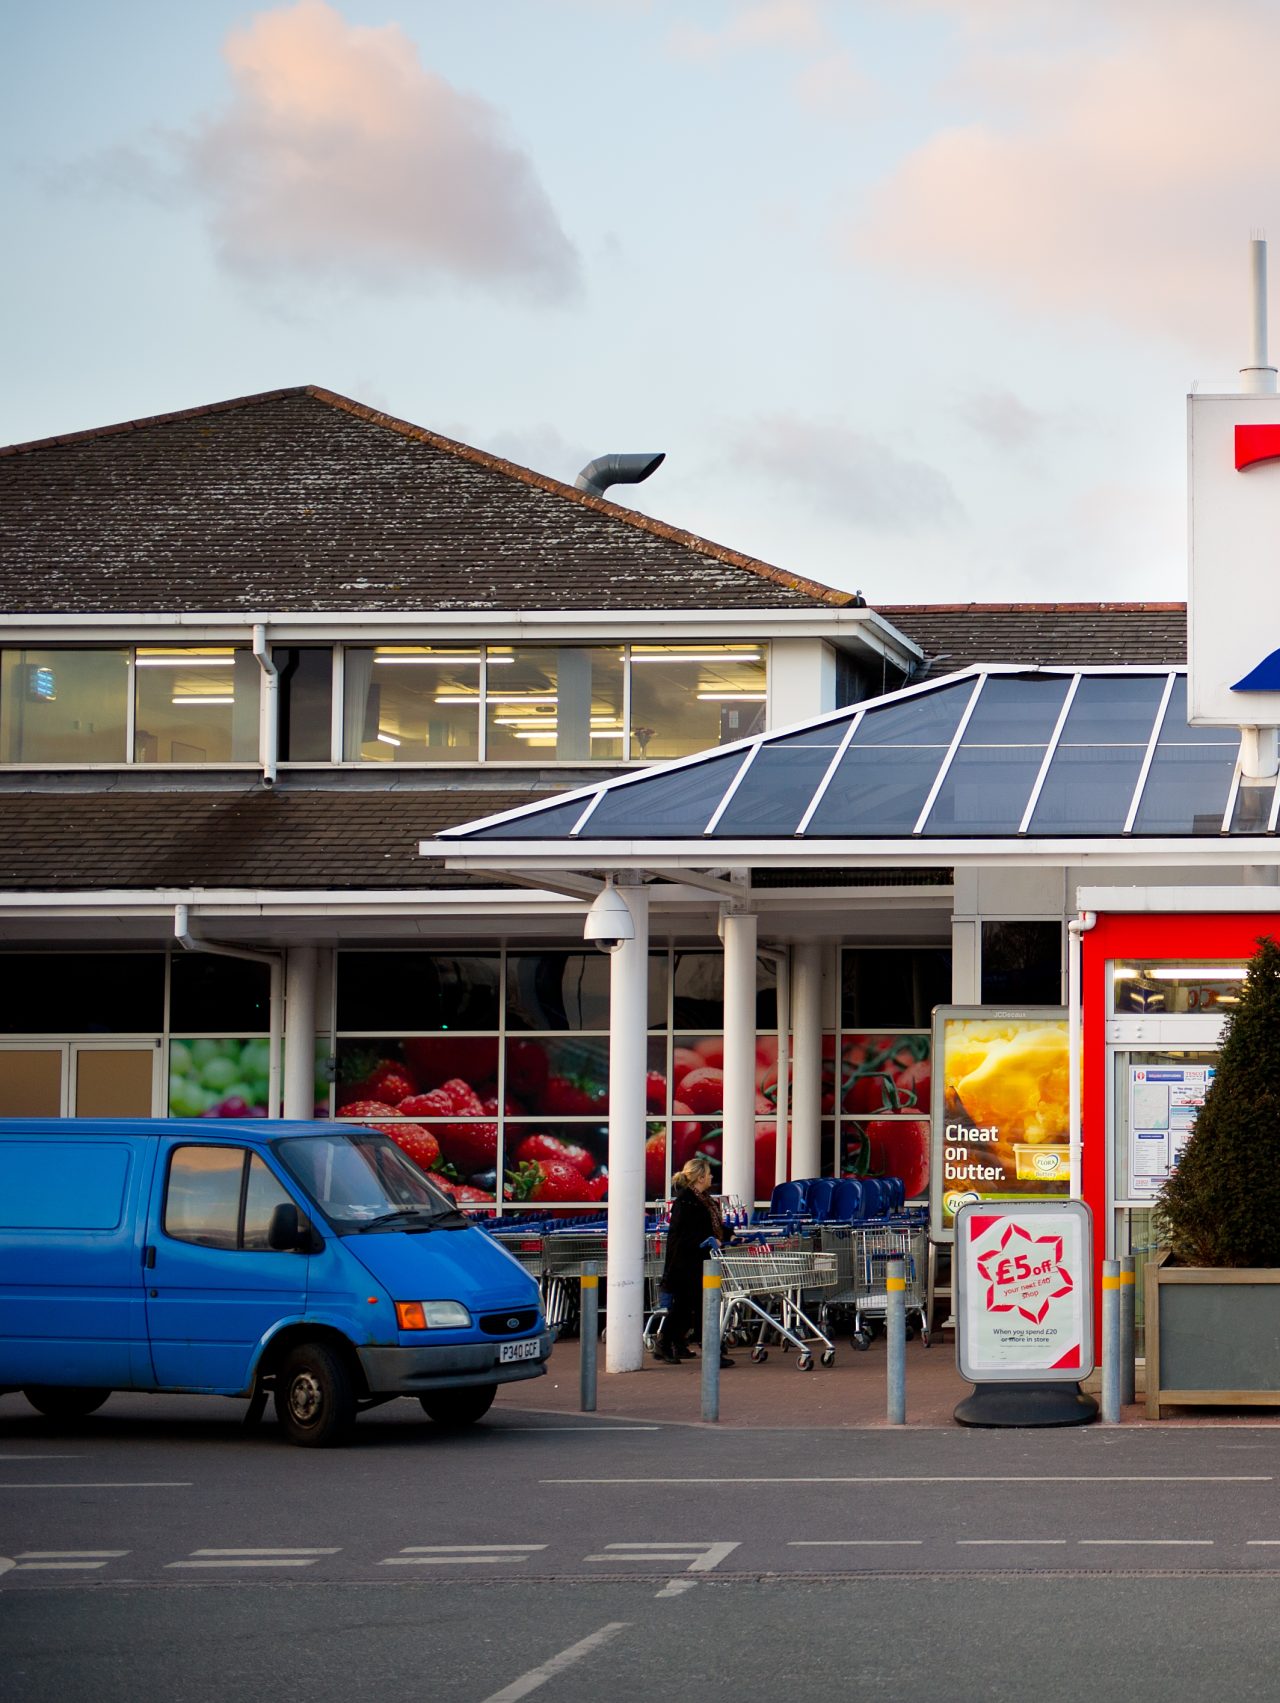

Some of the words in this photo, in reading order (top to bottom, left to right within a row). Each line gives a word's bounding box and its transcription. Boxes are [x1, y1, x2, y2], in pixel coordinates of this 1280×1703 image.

[945, 1124, 999, 1142] Cheat
[944, 1147, 968, 1161] on
[944, 1163, 1006, 1181] butter.
[948, 1199, 966, 1208] FLO
[996, 1254, 1032, 1285] £5
[1033, 1259, 1052, 1275] off
[1003, 1287, 1020, 1297] your
[1022, 1290, 1039, 1299] shop
[1025, 1328, 1045, 1336] spend
[503, 1344, 523, 1360] P340
